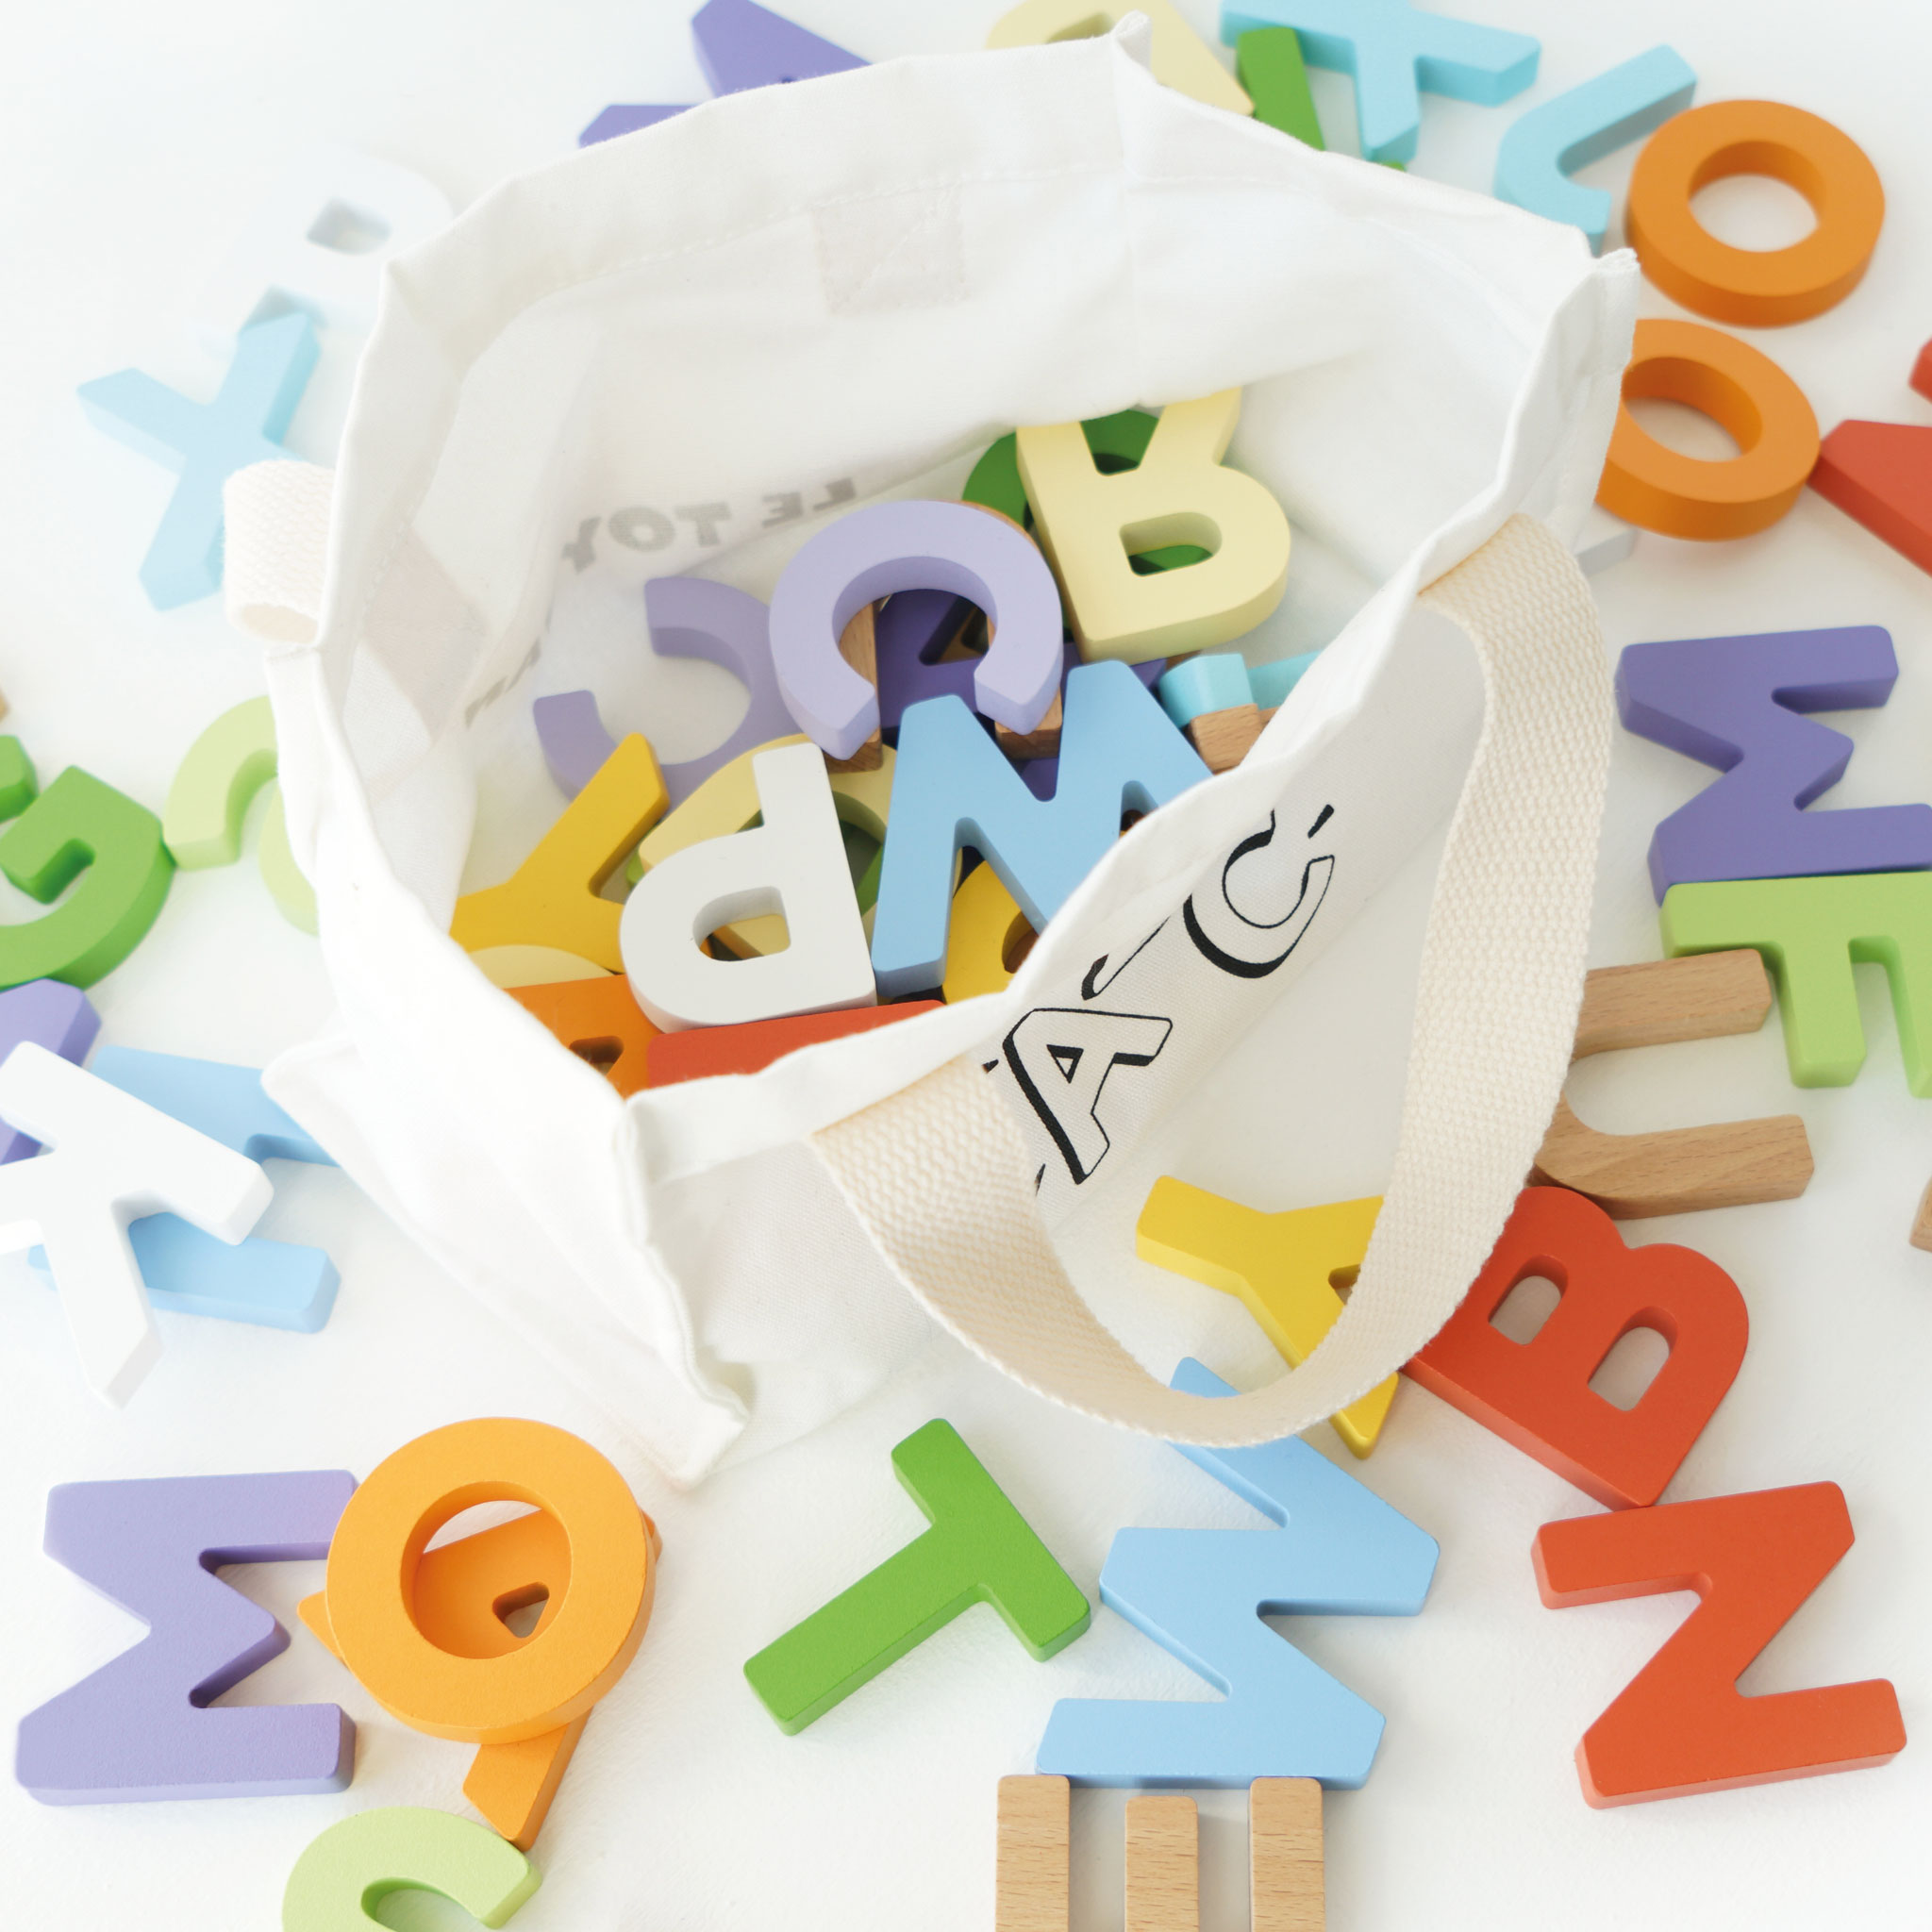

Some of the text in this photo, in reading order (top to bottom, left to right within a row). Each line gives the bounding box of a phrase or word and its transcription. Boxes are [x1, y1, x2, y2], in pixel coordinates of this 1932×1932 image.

[1624, 98, 1886, 329] O
[769, 499, 1063, 759] C
[1404, 1184, 1751, 1511] B
[742, 1417, 1092, 1737] T
